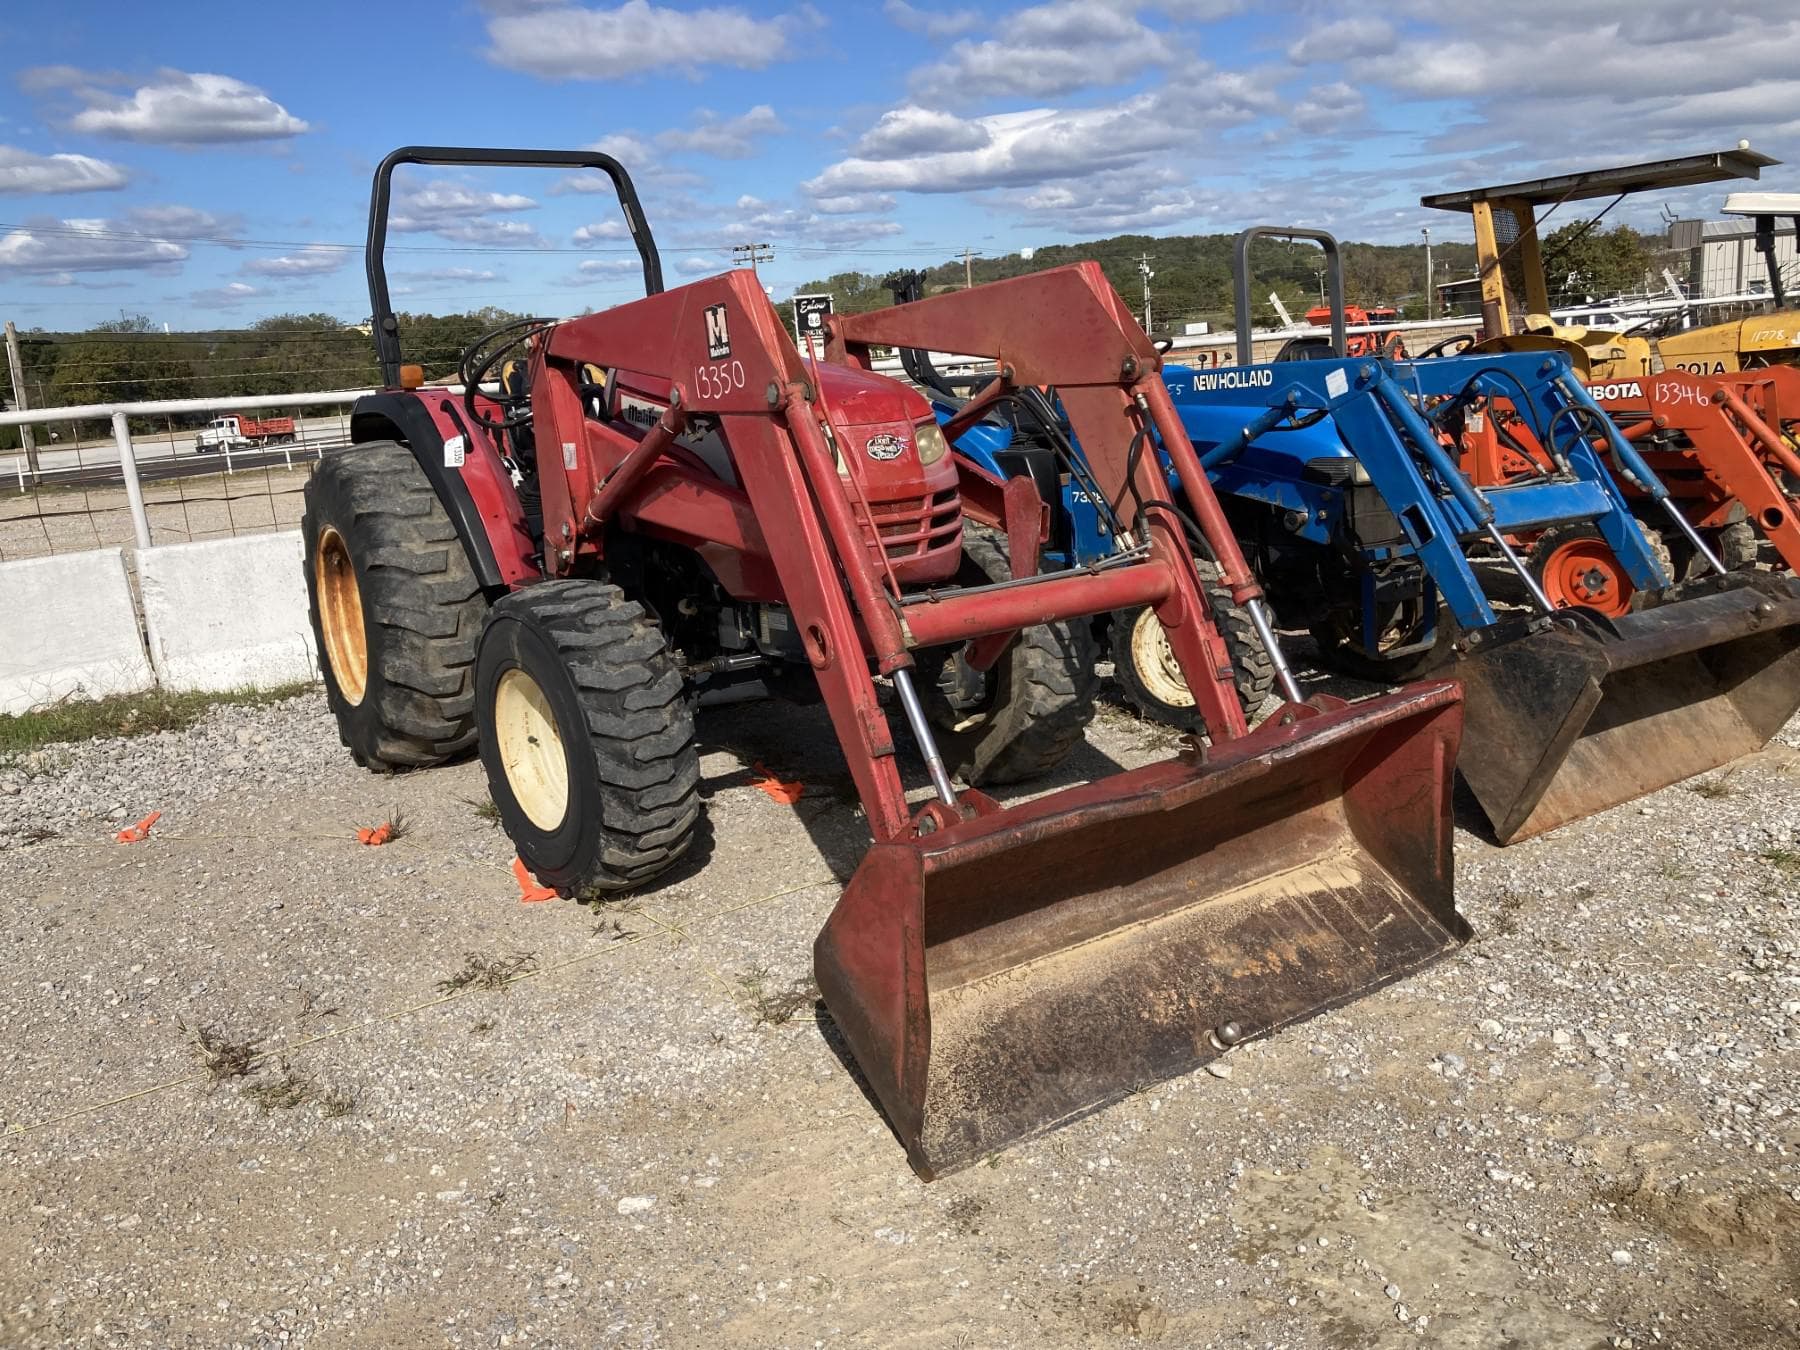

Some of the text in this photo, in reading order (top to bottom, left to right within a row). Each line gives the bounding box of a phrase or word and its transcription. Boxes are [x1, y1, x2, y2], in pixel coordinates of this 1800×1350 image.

[694, 361, 745, 399] 13350
[1193, 369, 1273, 391] NEW HOLLAND
[1655, 382, 1709, 406] 13346
